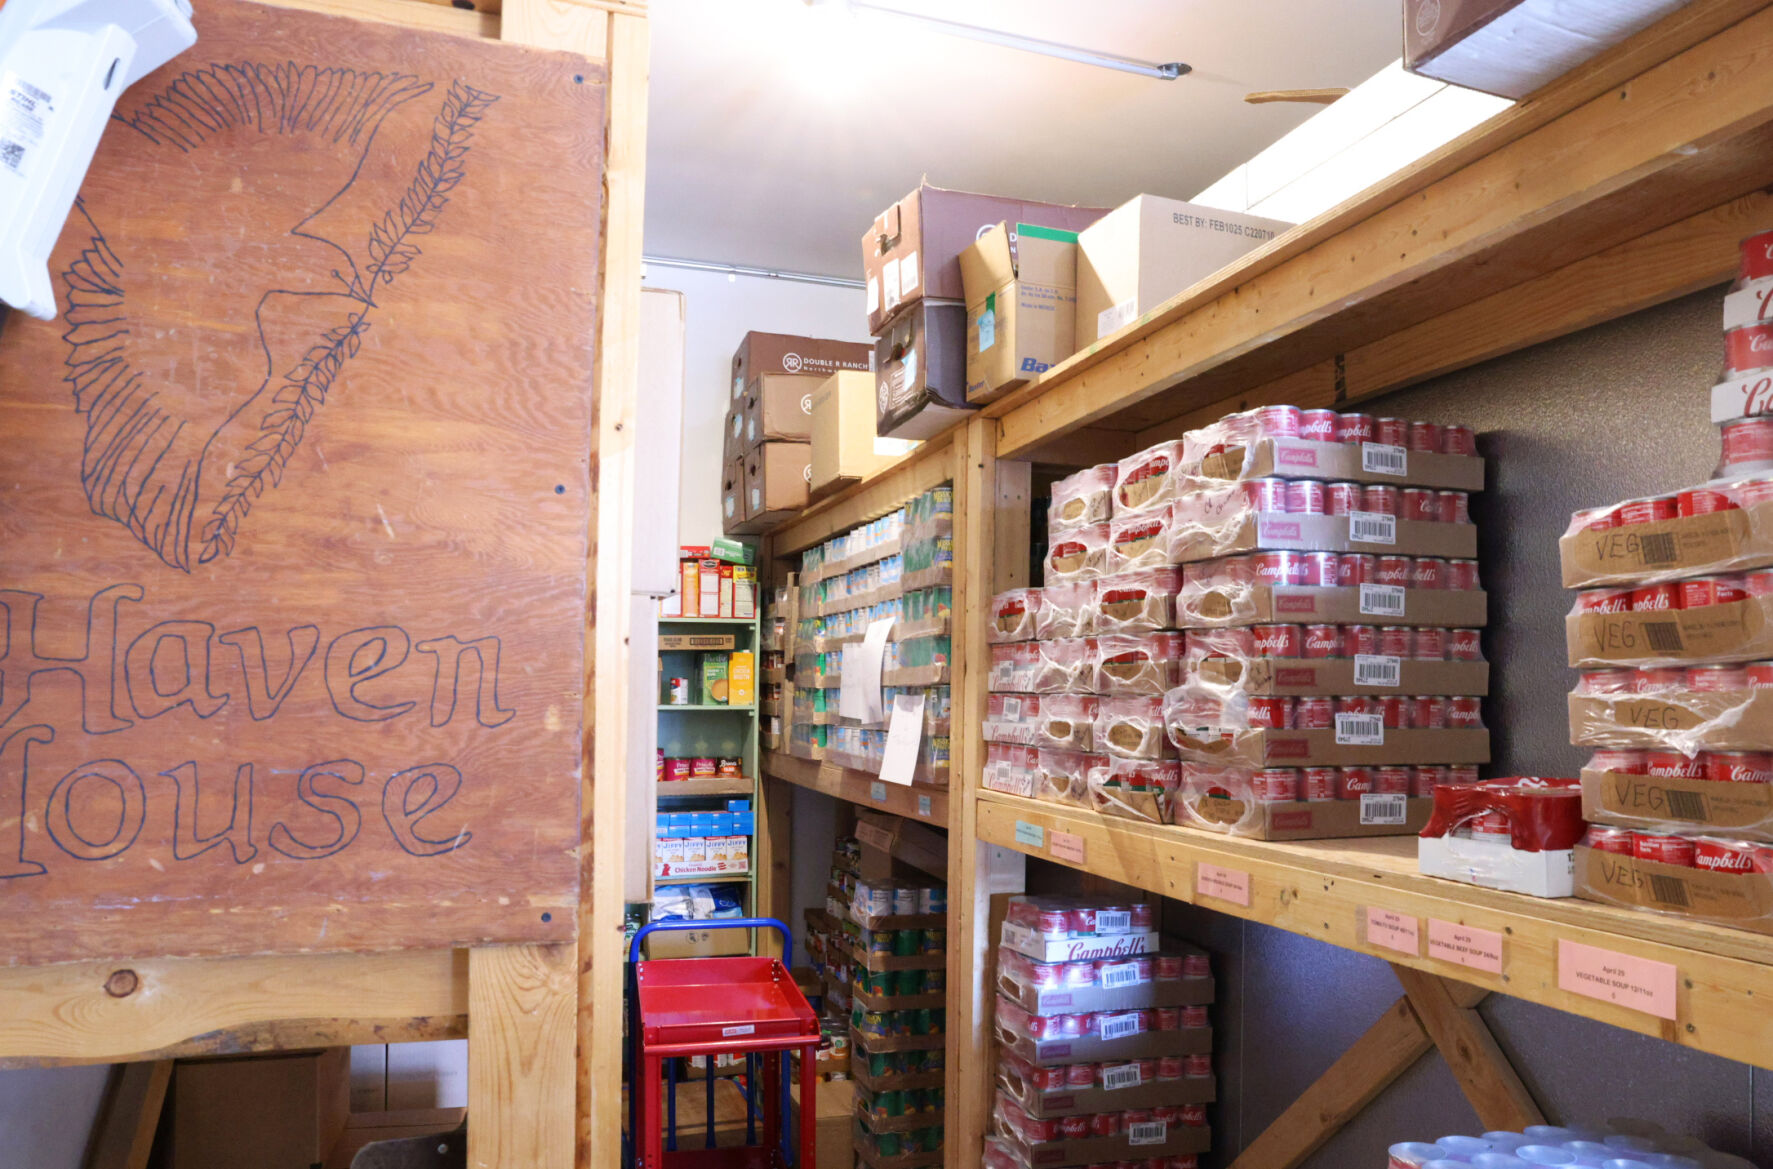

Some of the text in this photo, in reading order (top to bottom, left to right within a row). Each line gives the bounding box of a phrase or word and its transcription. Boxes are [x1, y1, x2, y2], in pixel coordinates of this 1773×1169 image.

[1173, 213, 1194, 226] BEST
[803, 357, 833, 367] DOUBLE
[842, 361, 869, 369] RANCH
[1021, 357, 1056, 373] Ba
[1596, 532, 1640, 561] VEG
[1594, 618, 1635, 652] VEG
[0, 584, 516, 735] Haven
[1630, 706, 1679, 730] VEG
[1615, 779, 1664, 810] VEG
[1602, 860, 1645, 888] VEG
[1067, 936, 1145, 960] Campbell's
[1576, 971, 1611, 986] VEGETABLE
[1612, 980, 1629, 990] SOUP
[1603, 966, 1617, 975] April
